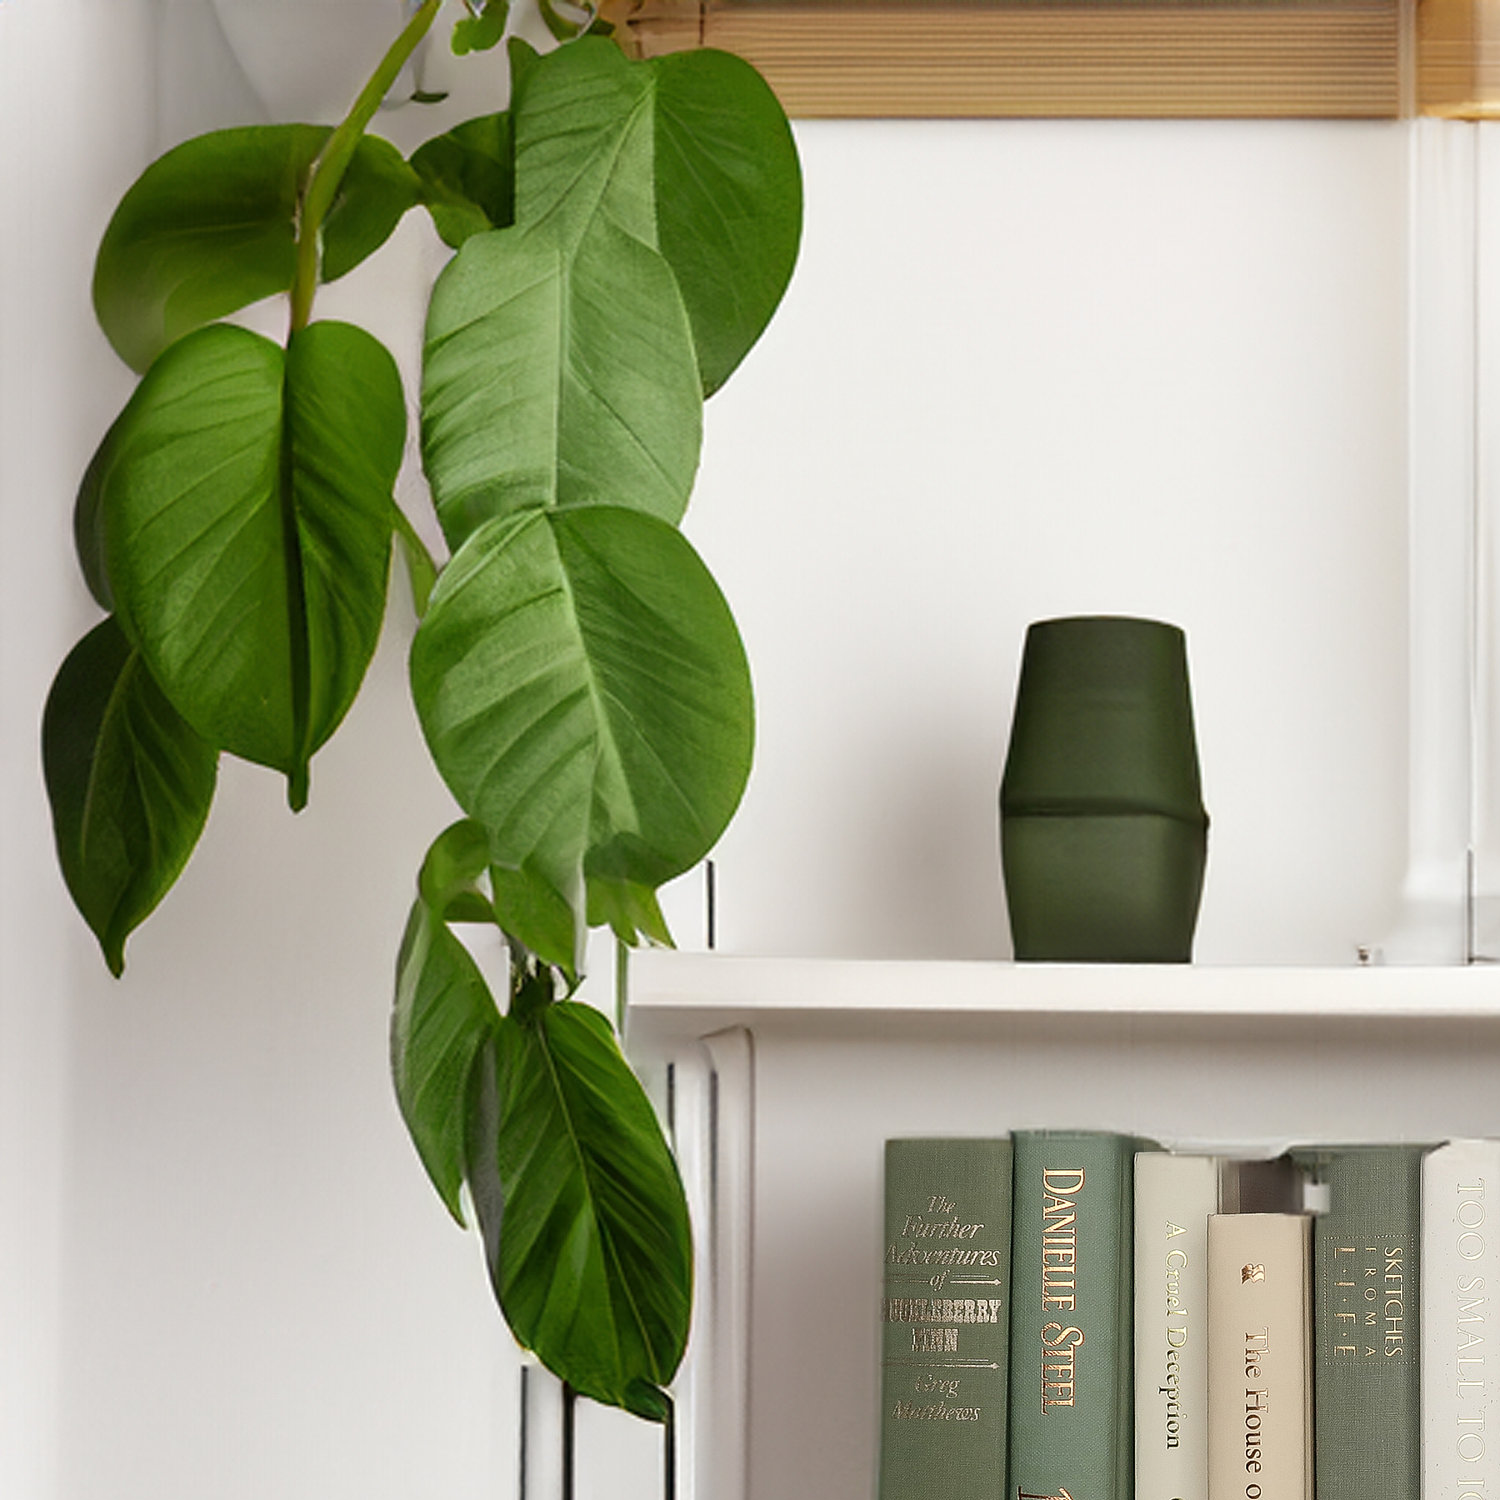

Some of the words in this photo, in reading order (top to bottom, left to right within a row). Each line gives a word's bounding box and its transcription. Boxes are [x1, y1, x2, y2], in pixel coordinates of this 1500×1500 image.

[901, 1214, 985, 1239] Further
[927, 1196, 956, 1214] The
[1164, 1221, 1188, 1241] A
[1456, 1177, 1486, 1262] TOO
[885, 1241, 1001, 1266] Adventures
[1041, 1166, 1086, 1312] DANIELLE
[929, 1269, 950, 1291] of
[1165, 1249, 1189, 1316] Cruel
[1364, 1247, 1377, 1326] FROM
[1383, 1247, 1404, 1358] SKETCHES
[1040, 1321, 1085, 1416] STEEL
[1244, 1327, 1270, 1379] The
[1364, 1346, 1377, 1358] A
[1456, 1274, 1486, 1399] SMALL
[1157, 1326, 1189, 1451] Deception
[1244, 1388, 1270, 1474] House
[1456, 1411, 1486, 1463] TO
